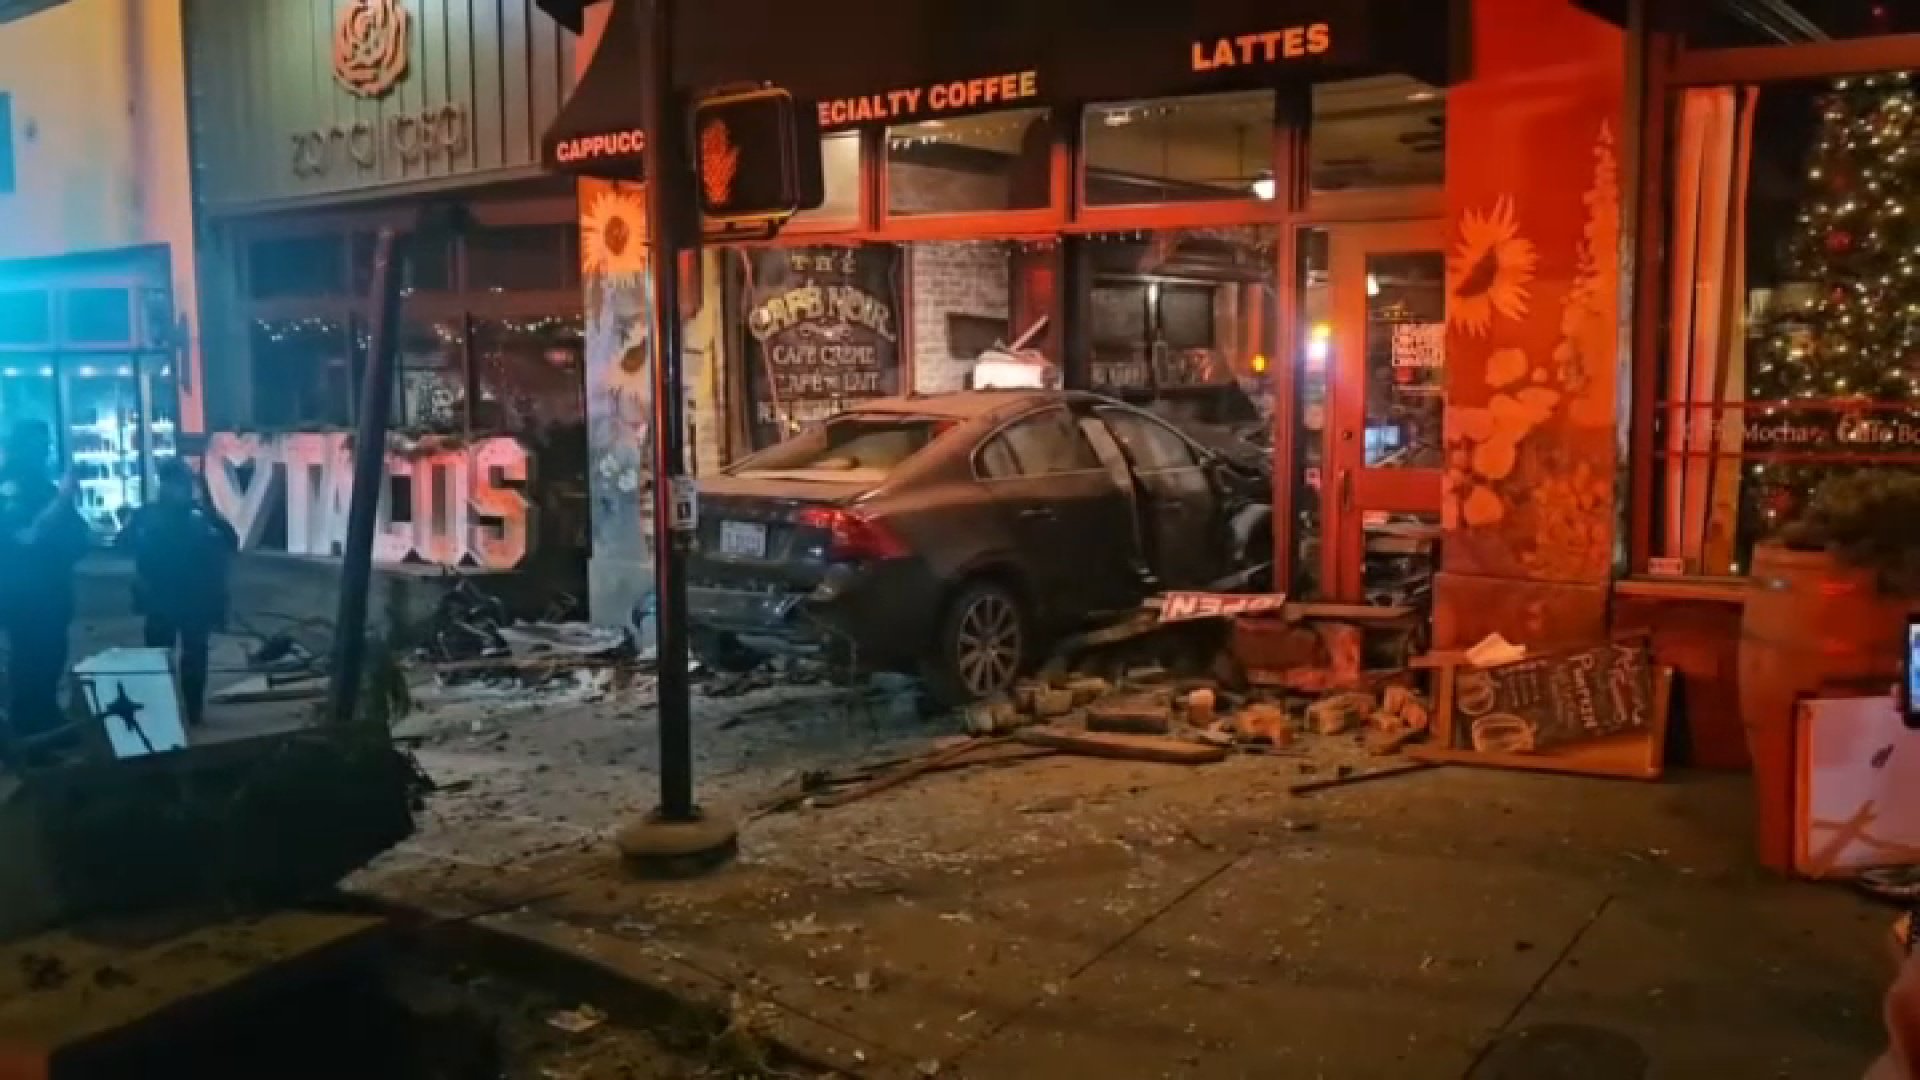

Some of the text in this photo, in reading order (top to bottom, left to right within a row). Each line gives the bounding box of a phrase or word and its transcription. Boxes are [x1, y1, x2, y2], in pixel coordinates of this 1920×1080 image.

[1191, 23, 1329, 71] LATTES
[817, 71, 1038, 126] ECIALTY COFFEE
[1167, 594, 1281, 619] OPEN
